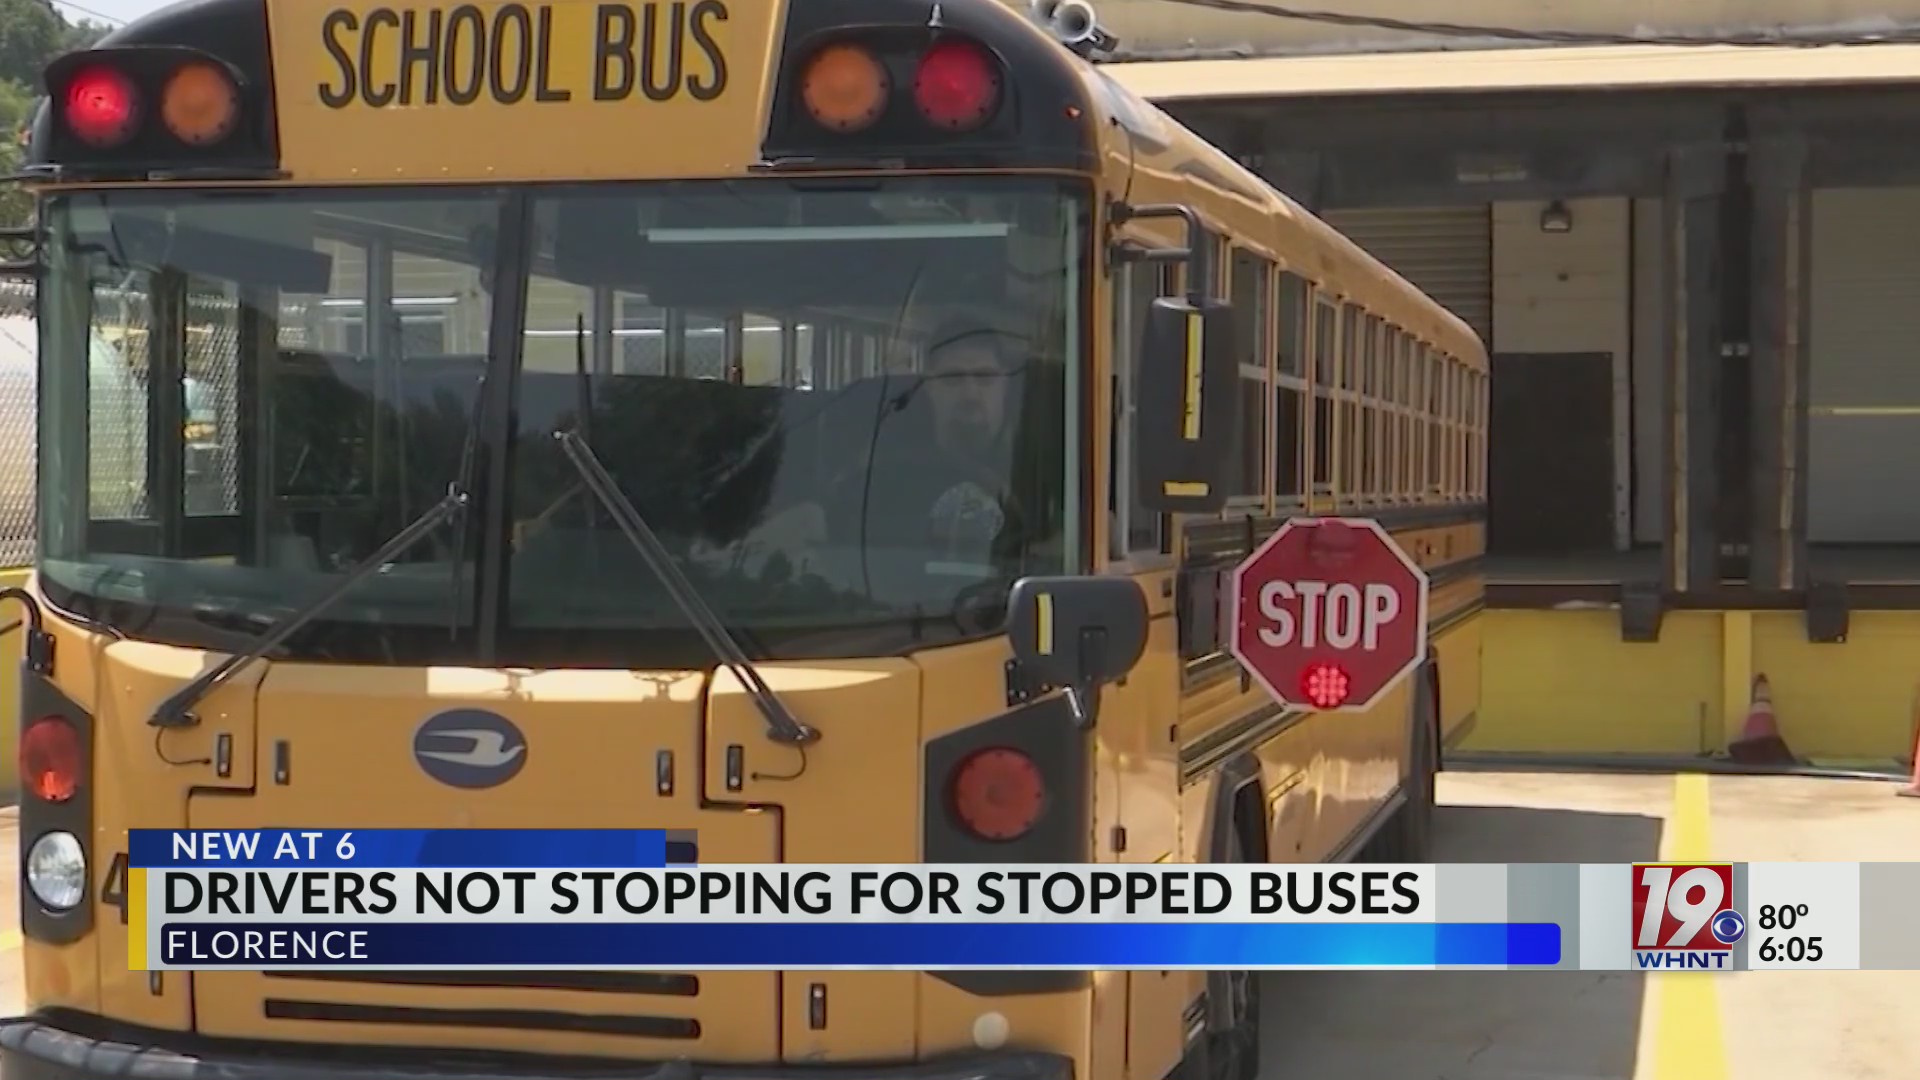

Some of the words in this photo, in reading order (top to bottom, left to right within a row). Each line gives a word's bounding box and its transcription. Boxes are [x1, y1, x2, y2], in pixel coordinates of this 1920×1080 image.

[318, 4, 572, 109] SCHOOL
[594, 0, 729, 102] BUS
[1258, 580, 1400, 650] STOP
